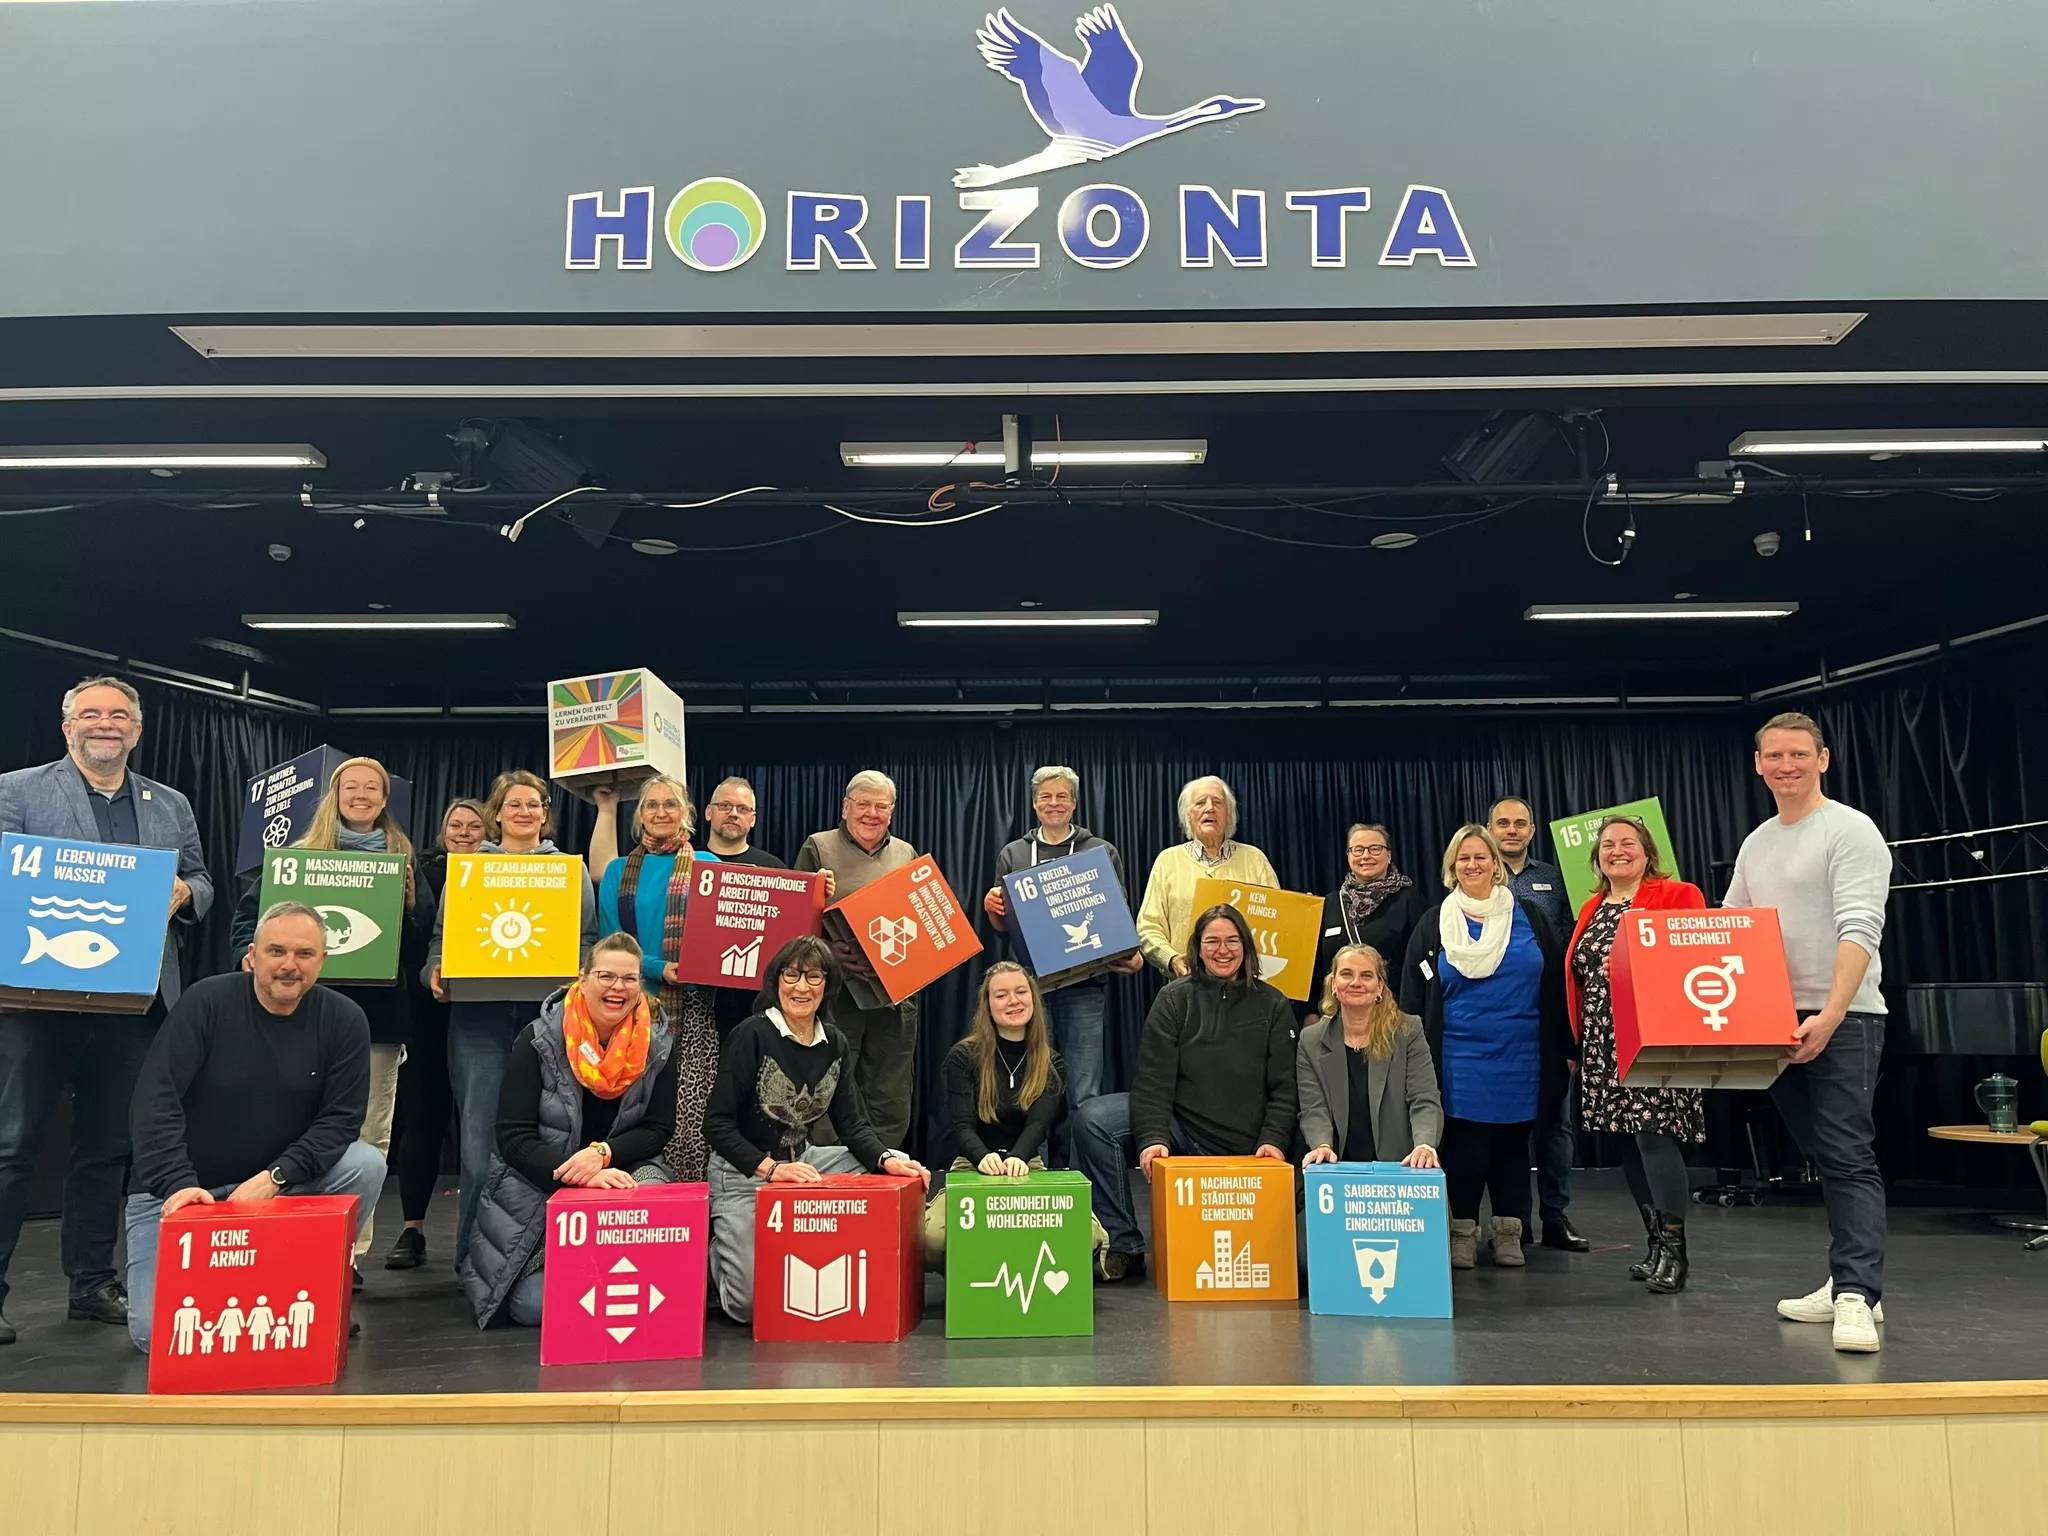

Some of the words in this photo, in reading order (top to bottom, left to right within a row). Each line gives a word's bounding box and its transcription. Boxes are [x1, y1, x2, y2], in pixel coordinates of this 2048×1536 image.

[564, 175, 1478, 273] HORIZONTA
[555, 708, 581, 718] LERNEN
[582, 705, 594, 714] DIE
[594, 703, 613, 713] WELT
[555, 719, 565, 727] ZU
[566, 712, 609, 725] VERÄNDERN.
[266, 774, 297, 796] SCHAFTEN
[268, 765, 297, 785] PARTNER-
[251, 778, 266, 804] 17
[265, 793, 278, 808] ZUR
[277, 777, 315, 802] ERREICHUNG
[264, 804, 276, 819] DER
[276, 797, 292, 814] ZIELE
[1559, 823, 1583, 849] 15
[10, 843, 43, 878] 14
[55, 848, 95, 866] LEBEN
[96, 852, 137, 870] UNTER
[305, 858, 377, 874] MASSNAHMEN
[377, 861, 400, 875] ZUM
[483, 861, 545, 874] BEZAHLBARE
[547, 862, 568, 874] UND
[54, 865, 107, 884] WASSER
[271, 857, 298, 886] 13
[303, 873, 375, 889] KLIMASCHUTZ
[459, 861, 473, 888] 7
[910, 864, 933, 884] 9
[1041, 868, 1099, 895] GERECHTIGKEIT
[483, 875, 528, 888] SAUBERE
[528, 876, 568, 889] ENERGIE
[698, 869, 715, 897] 8
[720, 871, 808, 893] MENSCHENWÜRDIGE
[1014, 876, 1039, 903] 16
[718, 885, 751, 901] ARBEIT
[750, 889, 770, 903] UND
[1045, 892, 1064, 907] UND
[1063, 883, 1093, 902] STARKE
[1229, 888, 1242, 908] 2
[1249, 891, 1267, 905] KEIN
[717, 899, 781, 919] WIRTSCHAFTS-
[918, 884, 947, 930] INNOVATION
[941, 925, 957, 945] UND
[1049, 892, 1107, 919] INSTITUTIONEN
[1247, 903, 1277, 919] HUNGER
[715, 914, 766, 932] WACHSTUM
[907, 891, 946, 952] INFRASTRUKTUR
[1666, 915, 1755, 931] GESCHLECHTER-
[1637, 918, 1657, 947] 5
[1668, 931, 1732, 946] GLEICHHEIT
[1174, 1177, 1194, 1206] 11
[1200, 1176, 1263, 1190] NACHHALTIGE
[1343, 1183, 1396, 1199] SAUBERES
[1396, 1184, 1440, 1199] WASSER
[793, 1199, 868, 1215] HOCHWERTIGE
[986, 1195, 1050, 1211] GESUNDHEIT
[1051, 1195, 1074, 1210] UND
[1200, 1191, 1236, 1206] STÄDTE
[1236, 1192, 1256, 1205] UND
[1318, 1183, 1335, 1215] 6
[1344, 1200, 1366, 1215] UND
[1367, 1199, 1414, 1216] SANITÄR-
[596, 1209, 649, 1227] WENIGER
[766, 1200, 784, 1233] 4
[959, 1196, 976, 1230] 3
[986, 1213, 1063, 1229] WOHLERGEHEN
[1201, 1207, 1254, 1221] GEMEINDEN
[555, 1210, 588, 1247] 10
[792, 1217, 838, 1233] BILDUNG
[1345, 1217, 1425, 1233] EINRICHTUNGEN
[210, 1229, 251, 1248] KEINE
[595, 1226, 690, 1246] UNGLEICHHEITEN
[178, 1231, 193, 1270] 1
[208, 1248, 258, 1269] ARMUT
